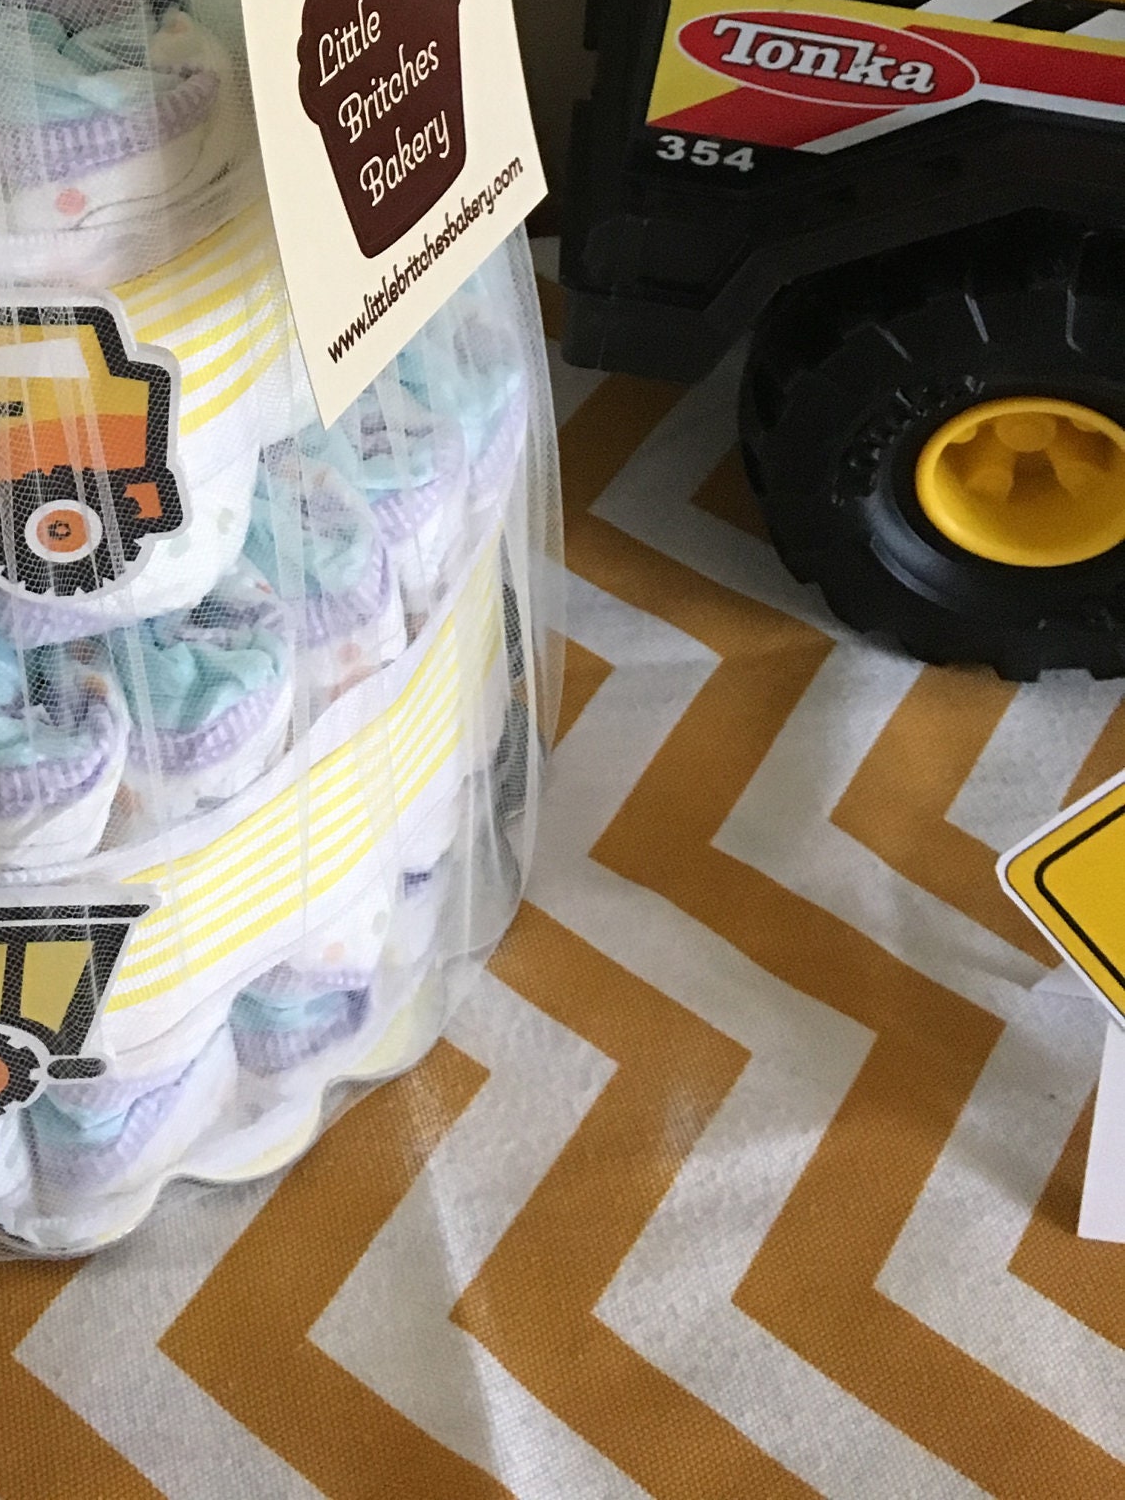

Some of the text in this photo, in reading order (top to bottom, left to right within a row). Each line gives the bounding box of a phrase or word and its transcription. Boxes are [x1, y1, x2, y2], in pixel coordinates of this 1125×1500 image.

[339, 39, 439, 143] Britches
[713, 18, 935, 94] Tonka
[360, 110, 450, 206] Bakery
[656, 135, 754, 172] 354
[328, 156, 523, 363] www.littlebritchesbakery.com
